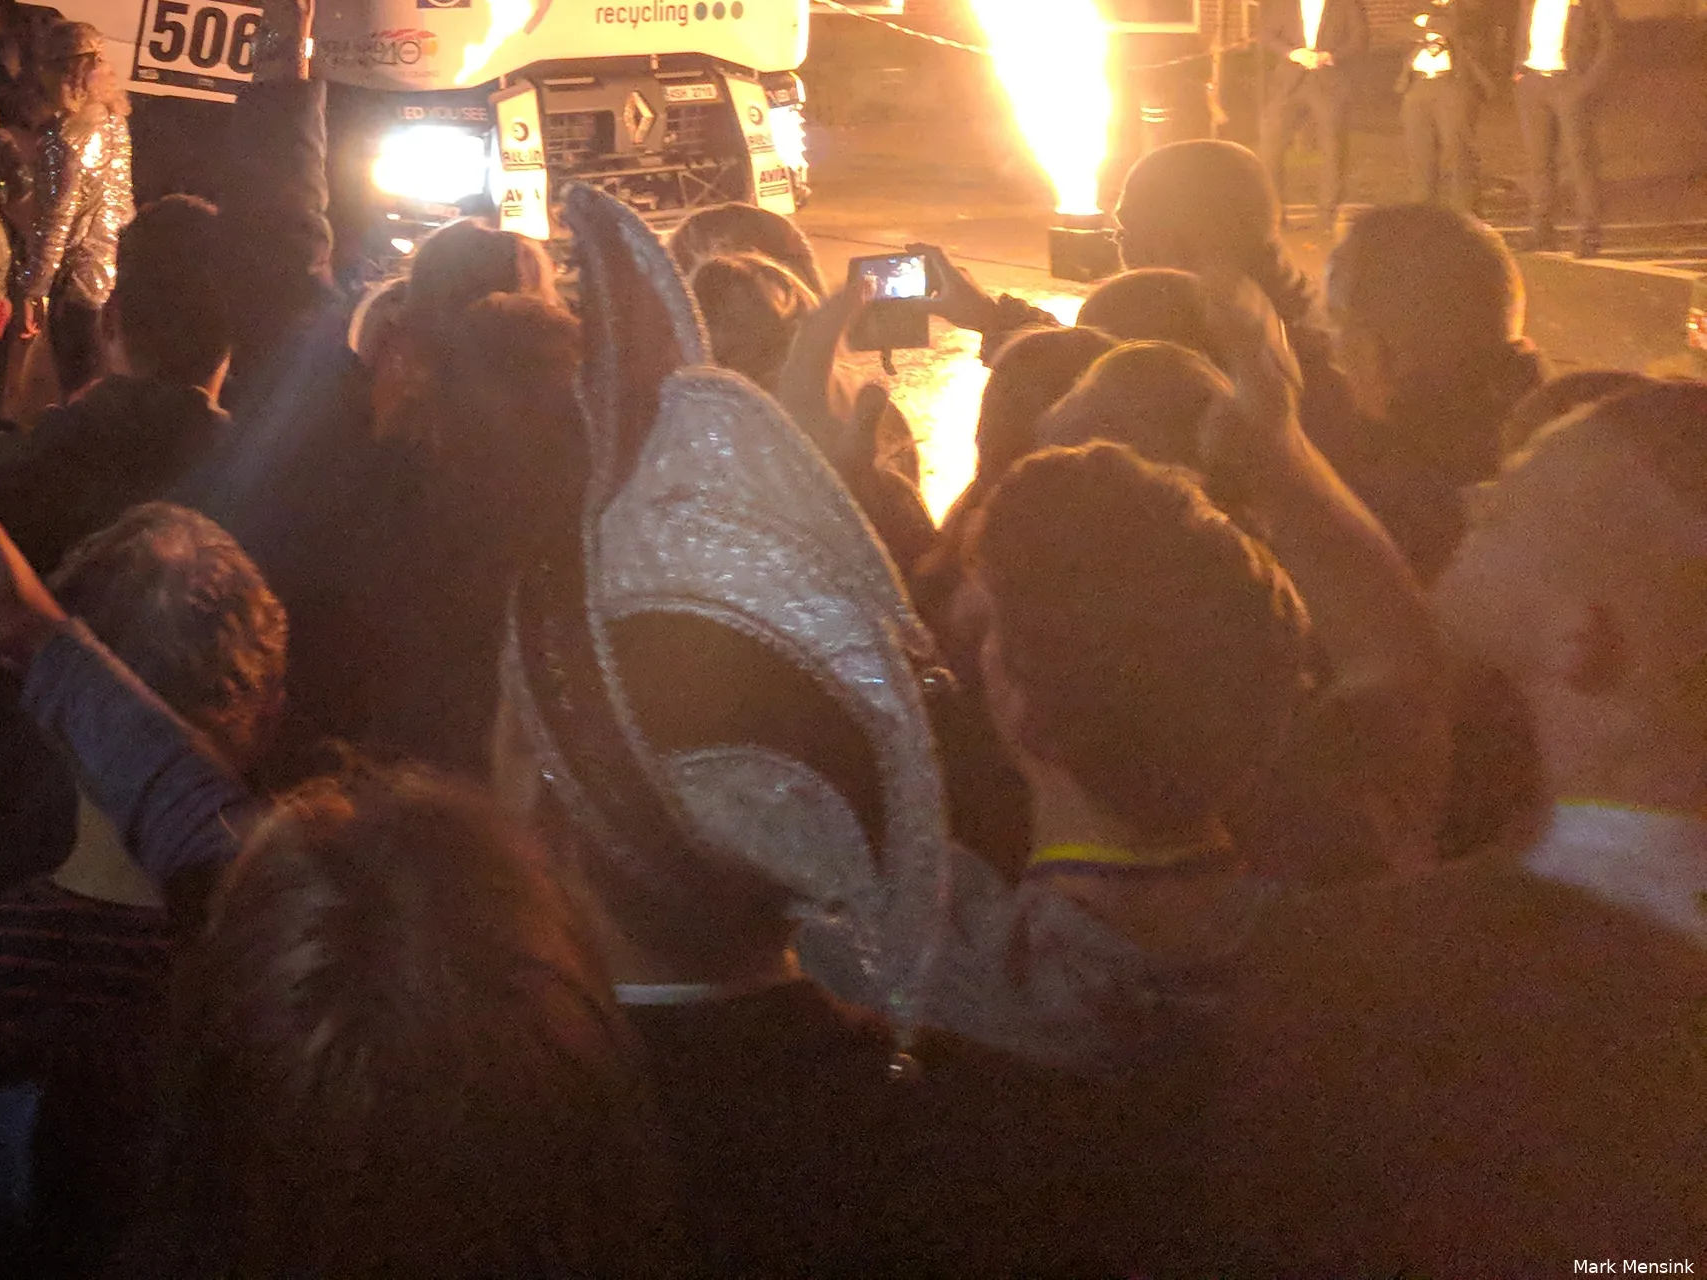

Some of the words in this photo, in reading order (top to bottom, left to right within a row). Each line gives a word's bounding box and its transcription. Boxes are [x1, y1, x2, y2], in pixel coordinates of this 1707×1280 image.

[595, 0, 690, 27] recycling
[400, 105, 424, 120] LED
[461, 106, 489, 121] SEE
[759, 170, 790, 188] AVIA
[505, 188, 541, 202] AV
